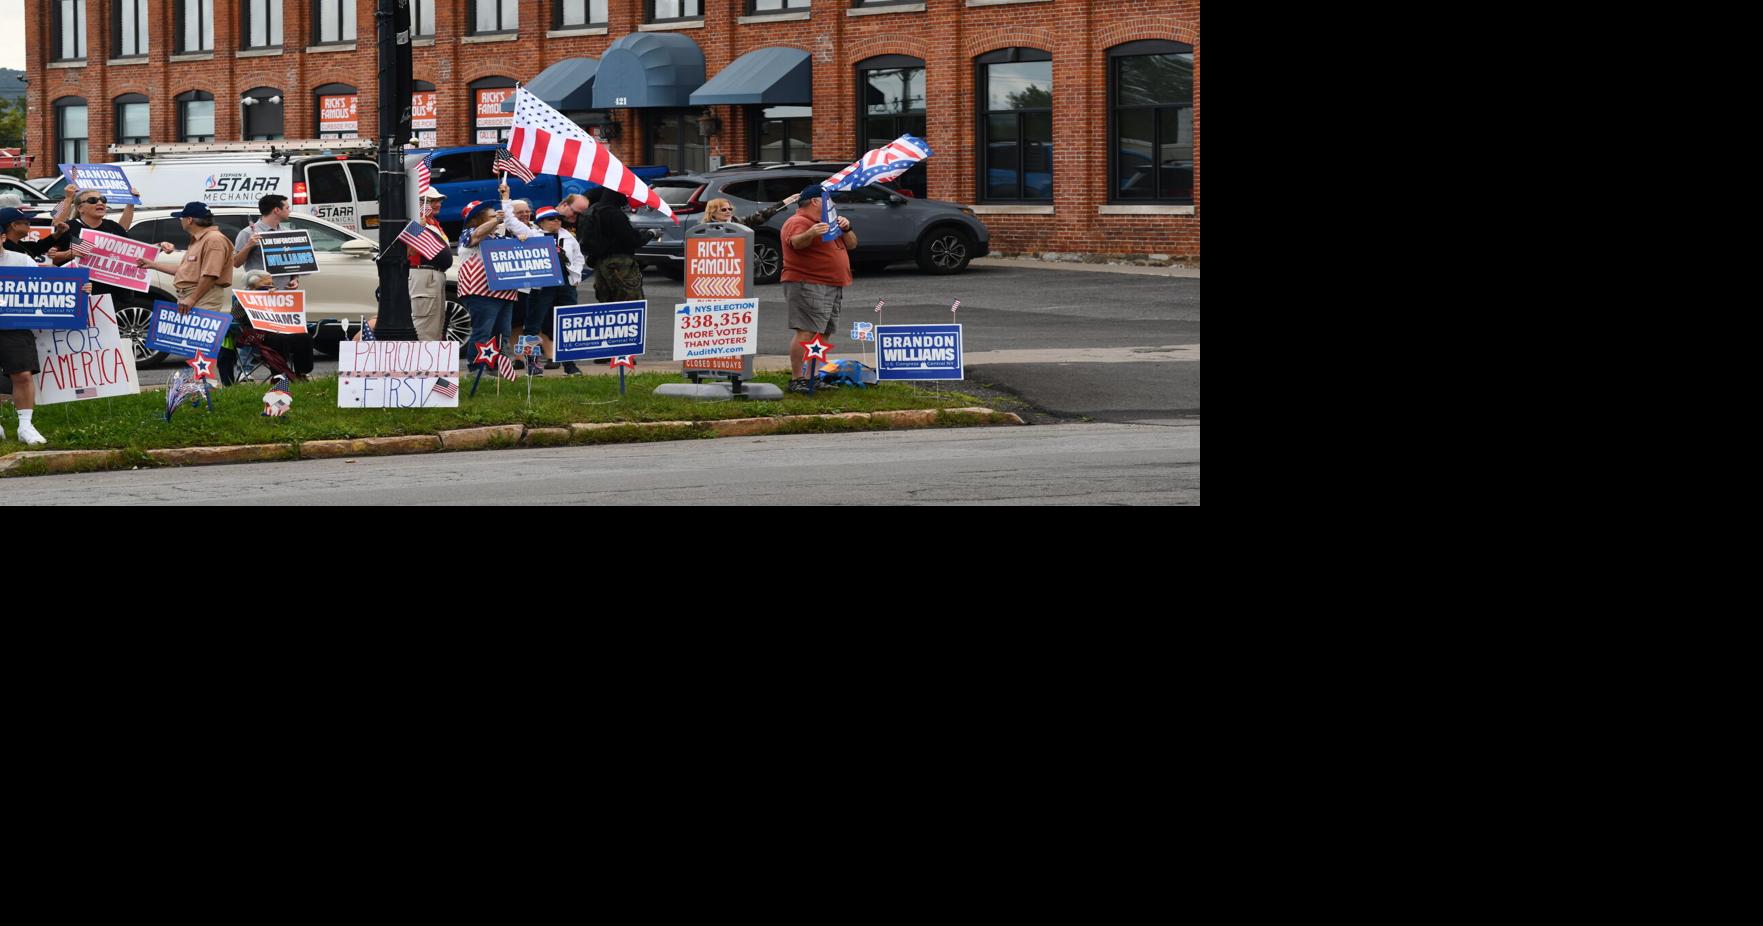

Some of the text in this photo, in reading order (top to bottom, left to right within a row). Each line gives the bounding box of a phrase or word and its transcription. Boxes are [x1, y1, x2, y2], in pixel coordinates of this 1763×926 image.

[324, 97, 346, 108] RICK'S
[482, 92, 504, 102] RICK'S
[321, 108, 349, 119] FAMOUS
[74, 179, 128, 190] WILLIAMS
[206, 177, 280, 192] STARR
[204, 193, 274, 201] MECHANIC
[316, 206, 354, 218] STARR
[95, 236, 146, 257] WOMEN
[698, 241, 734, 257] RICK'S
[266, 252, 314, 266] WILLIAMS
[490, 248, 550, 261] BRANDON
[79, 255, 147, 280] WILLIAMS
[493, 258, 552, 273] WILLIAMS
[691, 259, 741, 275] FAMOUS
[243, 294, 295, 307] LATINOS
[714, 302, 755, 311] ELECTION
[160, 309, 222, 330] BRANDON
[249, 309, 301, 325] WILLIAMS
[562, 312, 639, 329] BRANDON
[681, 311, 752, 329] 338,356
[158, 321, 216, 343] WILLIAMS
[563, 324, 638, 343] WILLIAMS
[684, 327, 748, 339] MORE VOTES
[52, 326, 102, 355] FOR
[684, 336, 747, 348] THAN VOTERS
[883, 336, 954, 348] BRANDON
[354, 341, 452, 372] PATRIOTISM
[686, 346, 744, 357] AuditNY.com
[884, 347, 955, 362] WILLIAMS
[40, 348, 129, 392] AMERICA
[364, 376, 428, 408] FIRST
